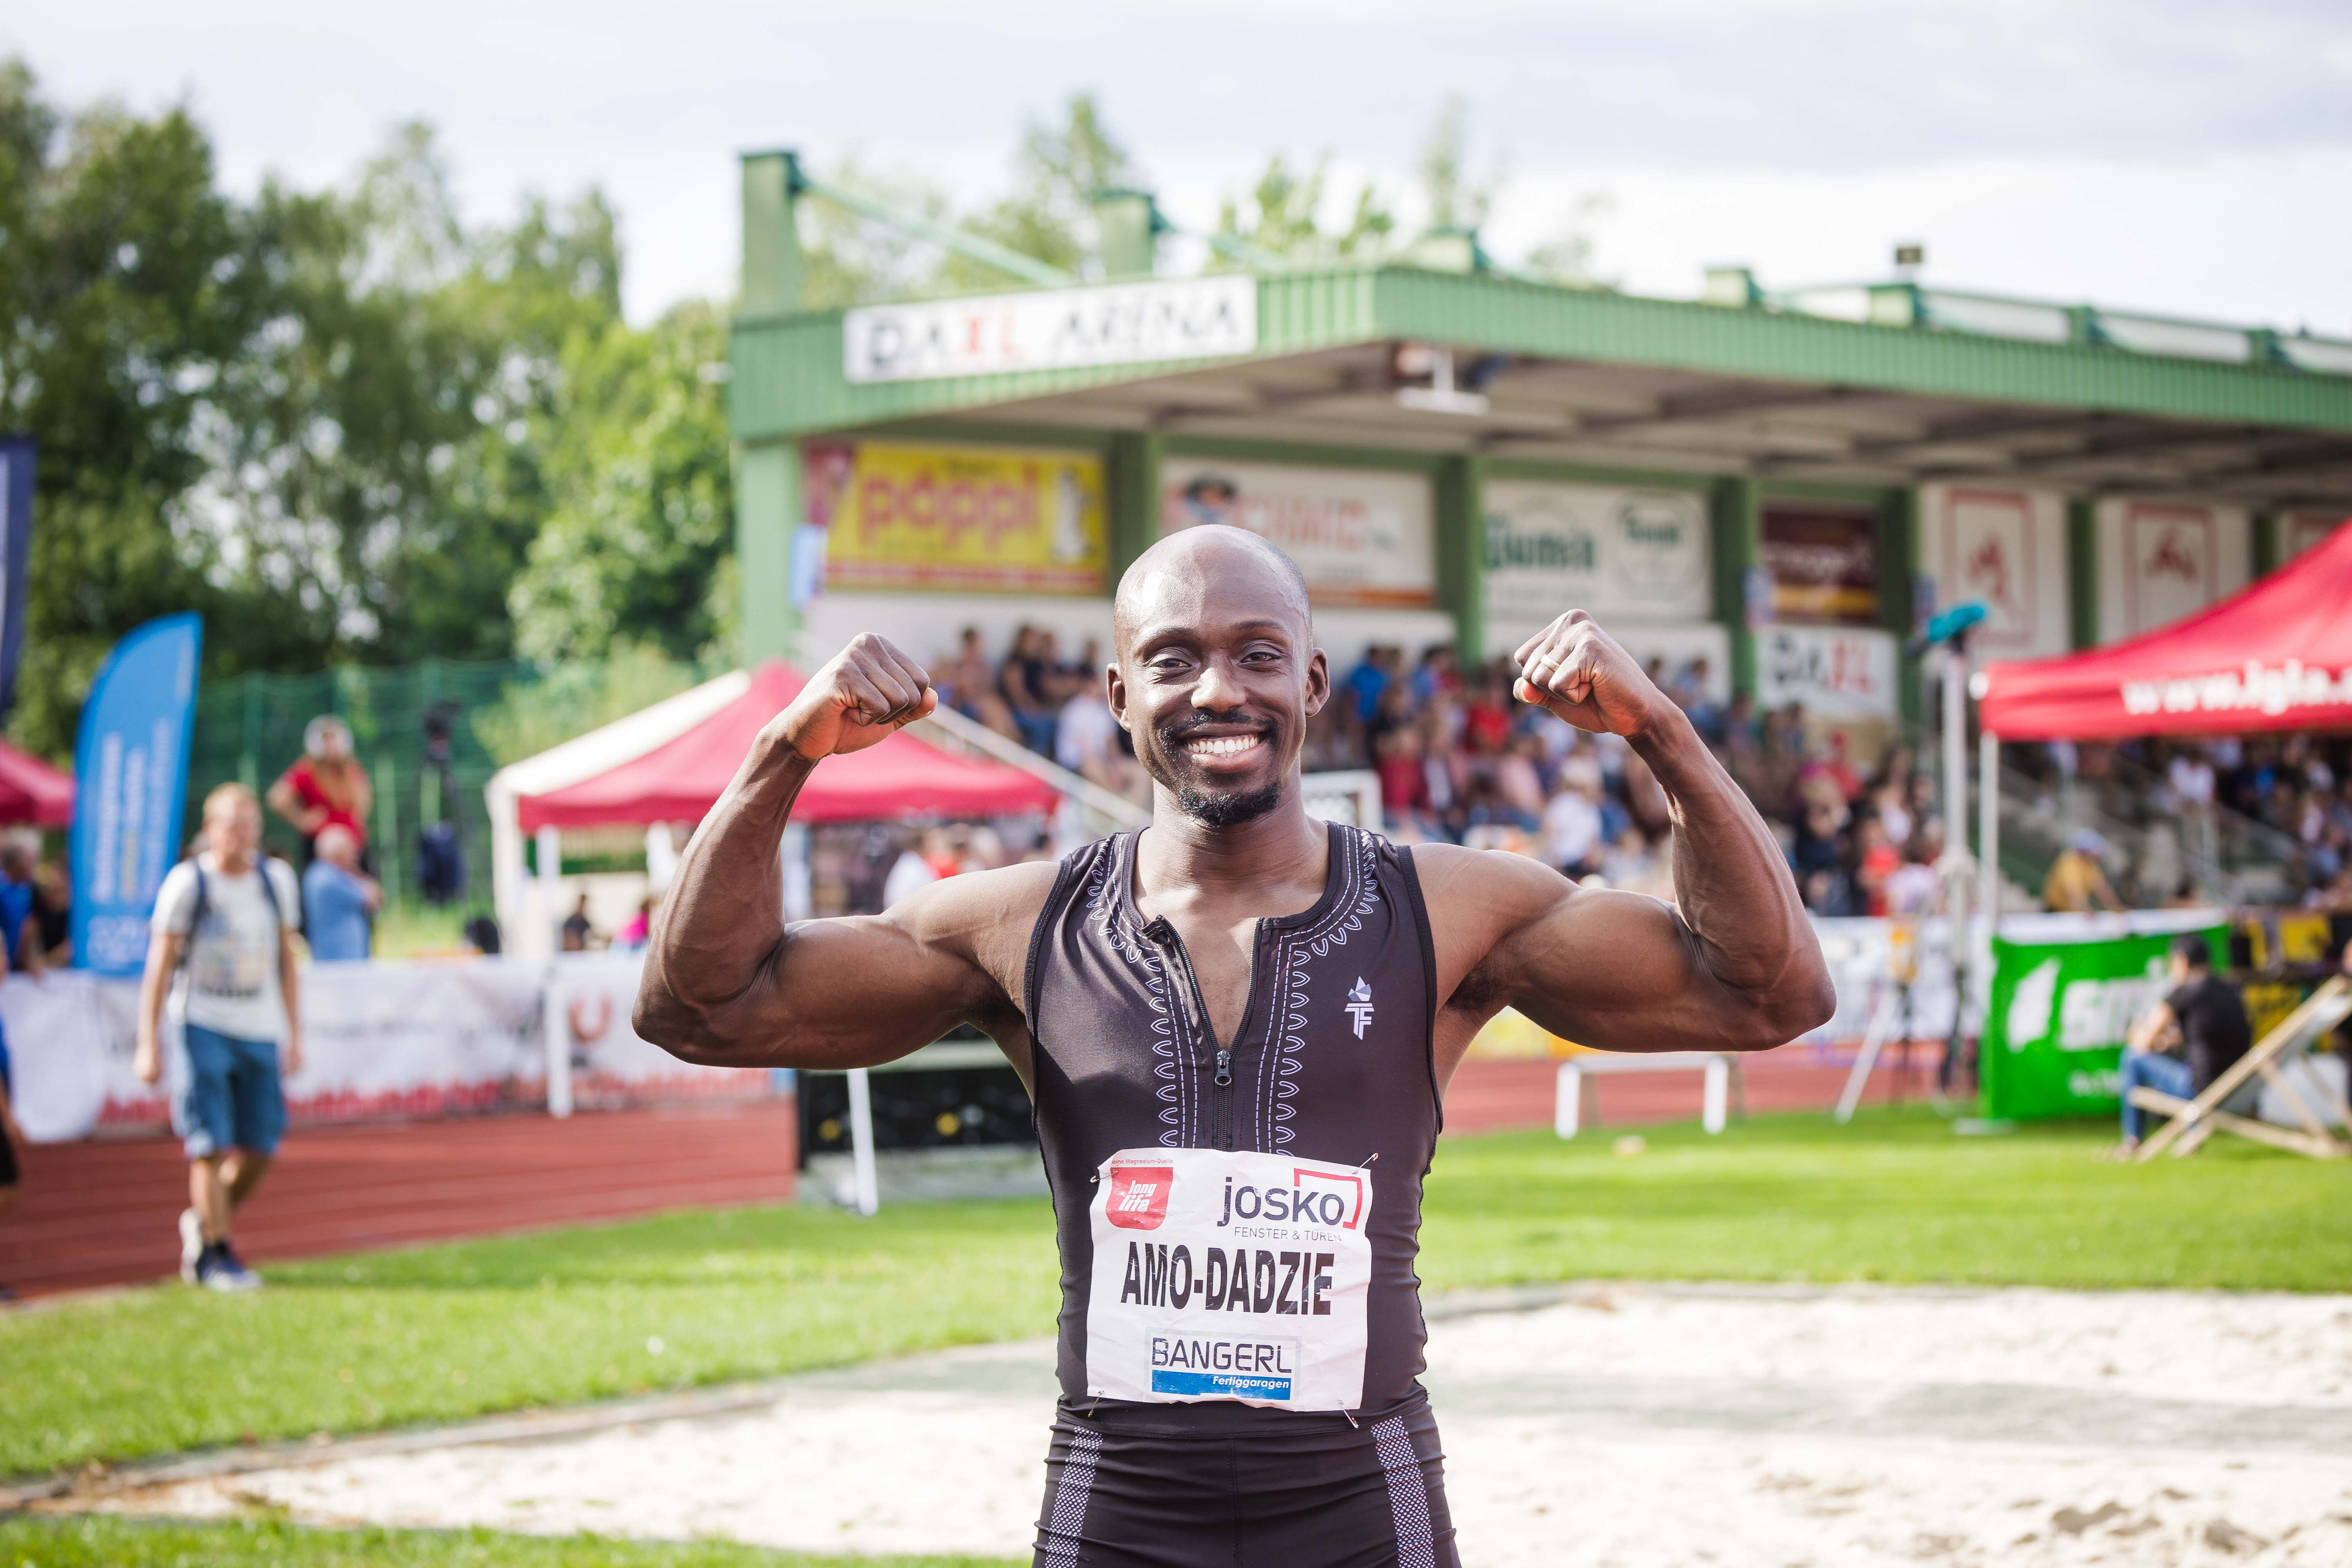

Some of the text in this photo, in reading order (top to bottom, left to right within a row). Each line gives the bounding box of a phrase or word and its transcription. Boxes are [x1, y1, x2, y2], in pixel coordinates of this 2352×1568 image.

[1051, 299, 1240, 352] ARENA
[1128, 1180, 1157, 1197] long
[1118, 1194, 1151, 1213] life
[1234, 1226, 1342, 1242] FENSTER & TÜREN
[1120, 1241, 1335, 1316] AMO-DADZIE
[1151, 1337, 1292, 1373] BANGERL
[1212, 1376, 1289, 1390] Fertiggaragen
